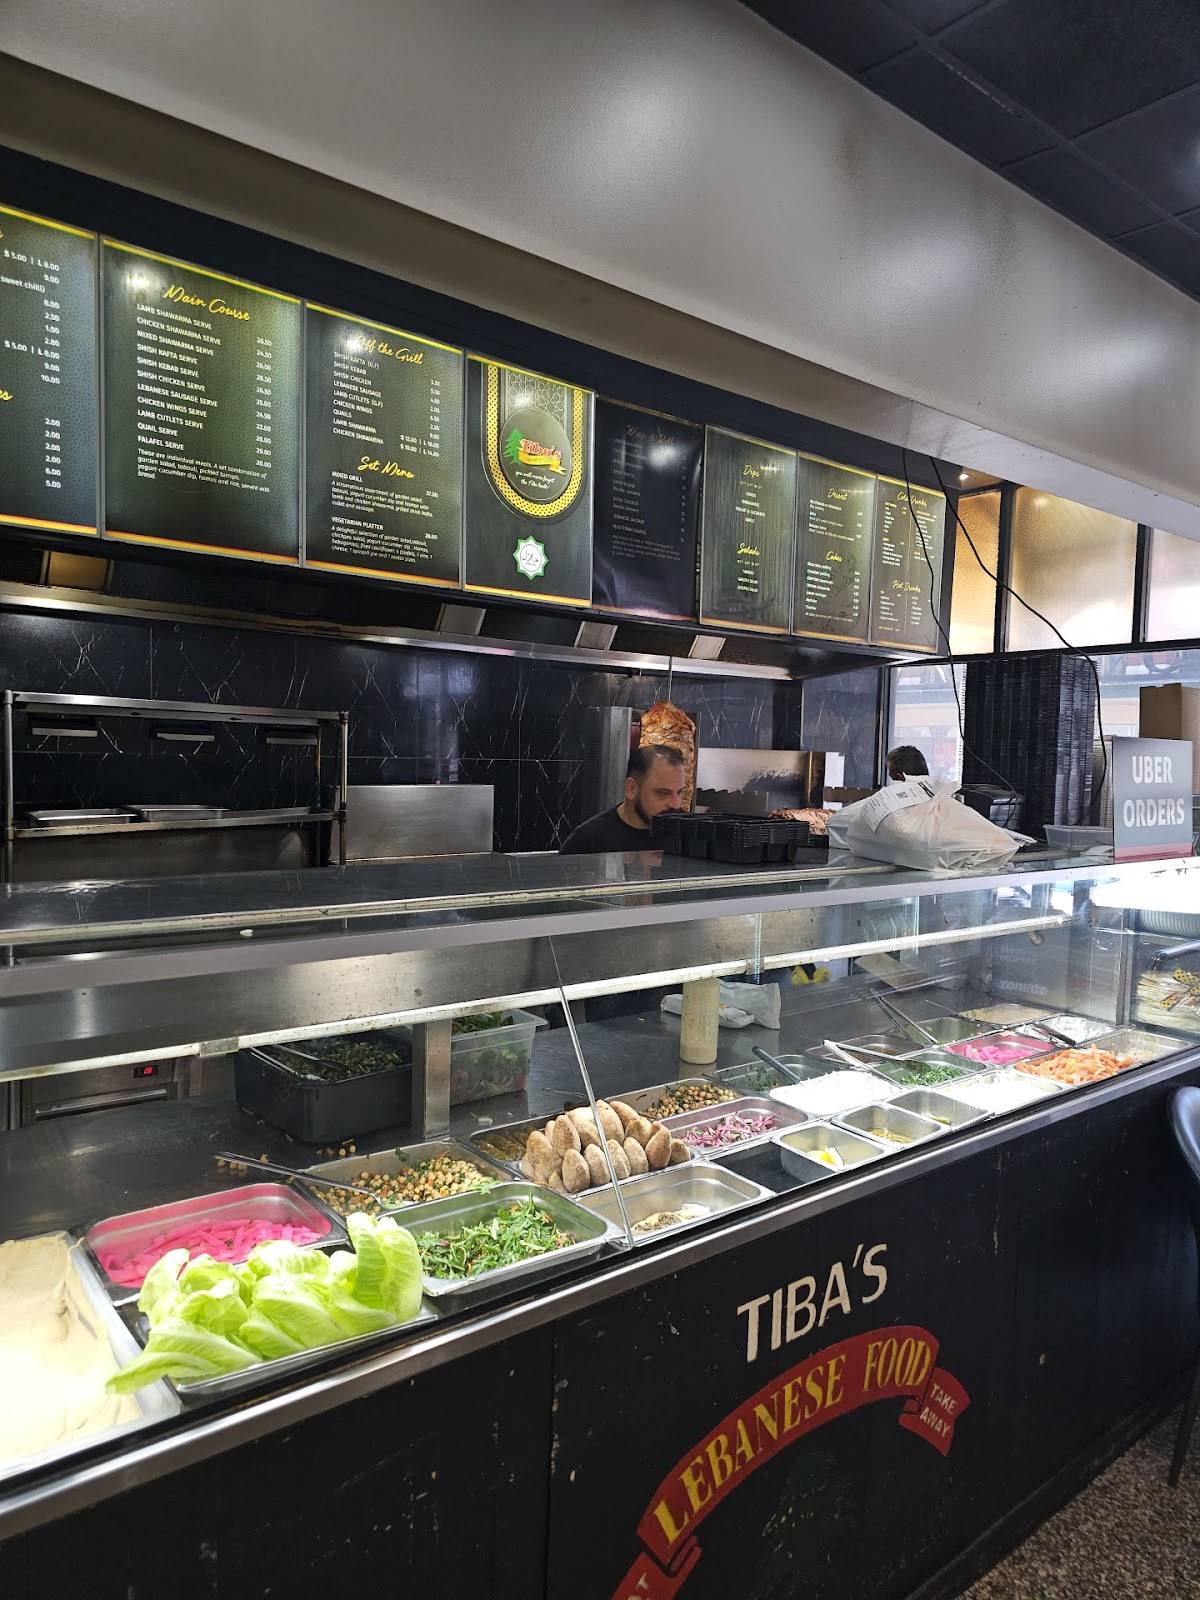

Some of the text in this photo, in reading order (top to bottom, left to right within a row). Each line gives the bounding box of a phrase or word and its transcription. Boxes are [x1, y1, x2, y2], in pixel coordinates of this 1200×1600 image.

[0, 276, 23, 288] sweet
[163, 285, 250, 321] Main Course
[137, 303, 212, 330] LAMB SHAWARMA SERVE
[137, 317, 222, 346] CHICKEN SHAWARMA SERVE
[11, 342, 27, 352] 5.00
[136, 343, 198, 365] SHISH KAFTA SERVE
[137, 330, 215, 356] MIXED SHAWARMA SERVE
[378, 342, 393, 356] the
[395, 348, 424, 365] Grill
[136, 356, 199, 378] SHISH KEBAB SERVE
[136, 370, 206, 392] SHISH CHICKEN SERVE
[333, 380, 358, 392] LEBANESE
[137, 383, 218, 408] LEBANESE SAUSAGE SERVE
[333, 399, 355, 410] CHICKEN
[137, 396, 208, 418] CHICKEN WINGS SERVE
[45, 418, 61, 427] 2.00
[137, 409, 204, 430] LAMB CUTLETS SERVE
[137, 422, 178, 437] QUAIL SERVE
[45, 430, 61, 440] 2.00
[137, 435, 184, 451] FALAFEL SERVE
[333, 427, 355, 438] CHICKEN
[45, 455, 61, 464] 2.00
[137, 448, 155, 458] These
[166, 453, 194, 465] individual
[137, 456, 158, 466] garden
[357, 456, 416, 479] Set Menu
[45, 480, 61, 489] 5.00
[331, 516, 362, 527] VEGETARIAN
[1132, 756, 1173, 784] UBER
[1122, 798, 1185, 828] ORDERS
[737, 1243, 888, 1362] TIBA'S
[930, 1382, 958, 1415] TAKE
[919, 1406, 951, 1438] AWAY
[653, 1337, 933, 1546] LEBANESE FOOD
